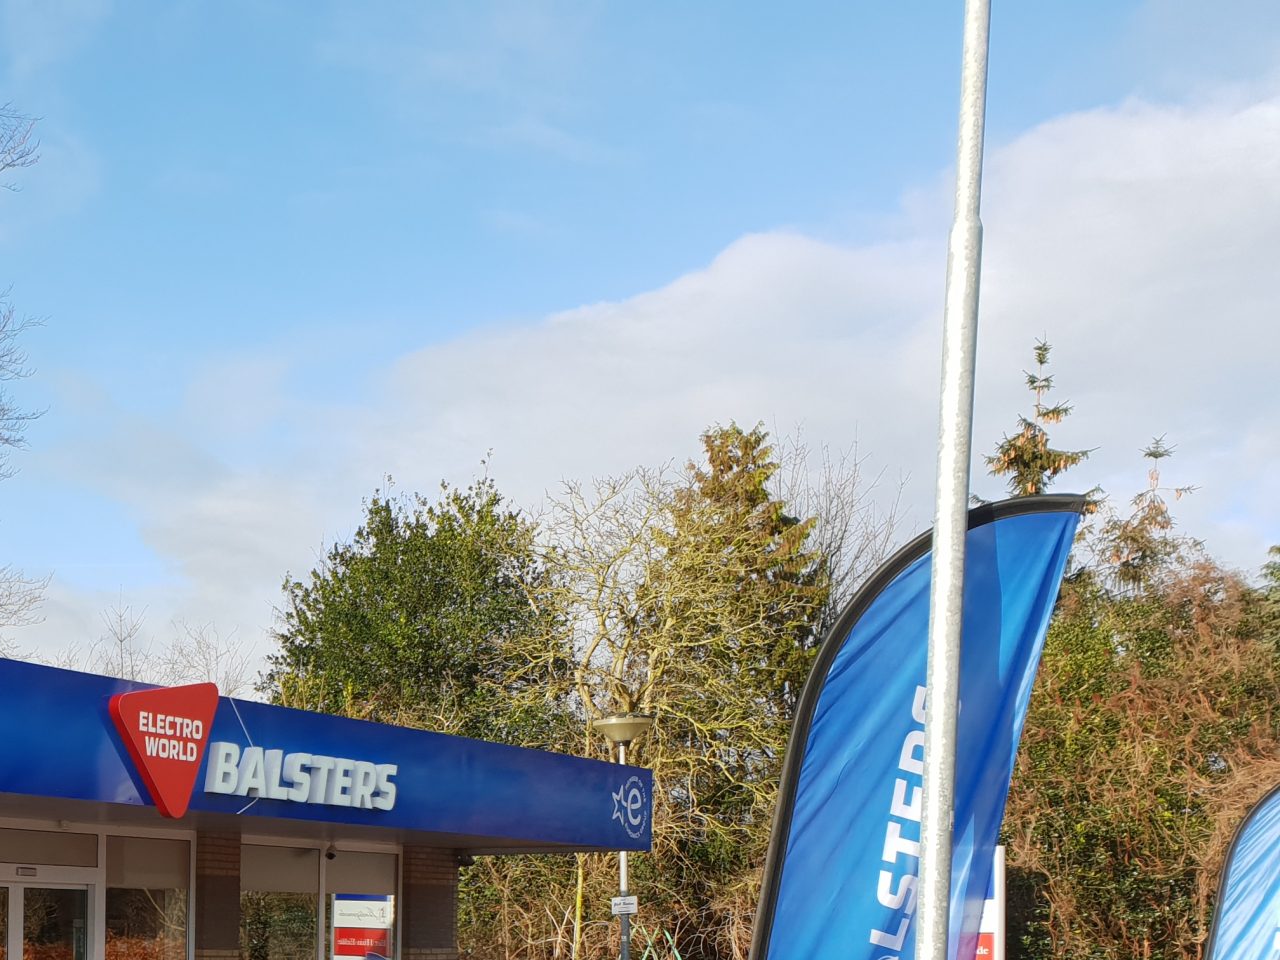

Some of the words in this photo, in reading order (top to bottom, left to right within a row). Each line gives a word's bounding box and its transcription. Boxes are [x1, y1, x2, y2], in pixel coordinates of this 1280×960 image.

[138, 710, 203, 741] ELECTRO
[144, 735, 197, 762] WORLD
[204, 741, 398, 811] BALSTERS
